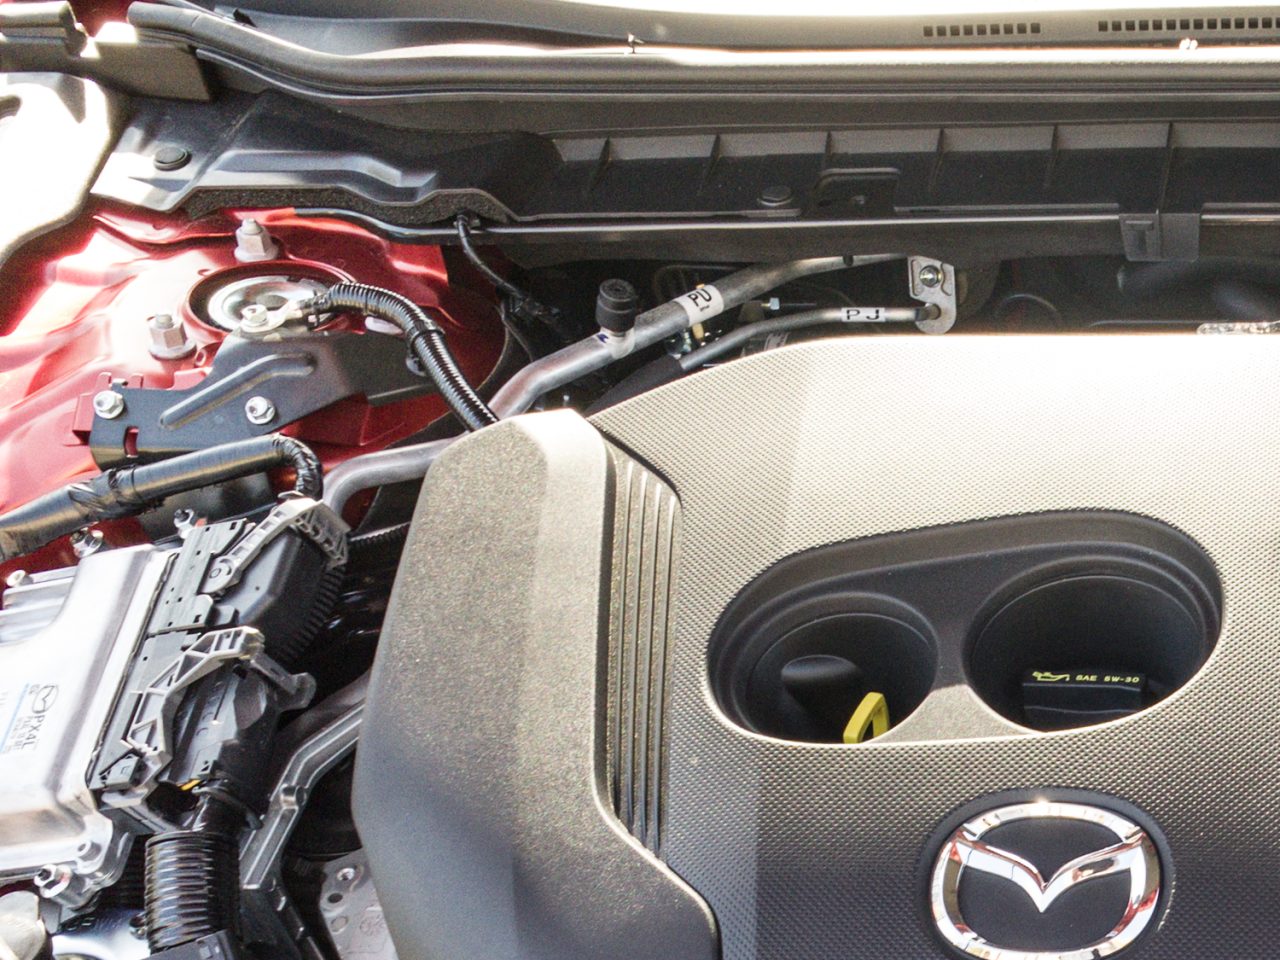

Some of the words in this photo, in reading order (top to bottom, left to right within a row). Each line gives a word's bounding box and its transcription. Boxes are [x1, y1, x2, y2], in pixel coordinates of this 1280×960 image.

[687, 288, 713, 307] PU
[1076, 674, 1097, 682] SAE
[1104, 675, 1140, 683] 5W-30
